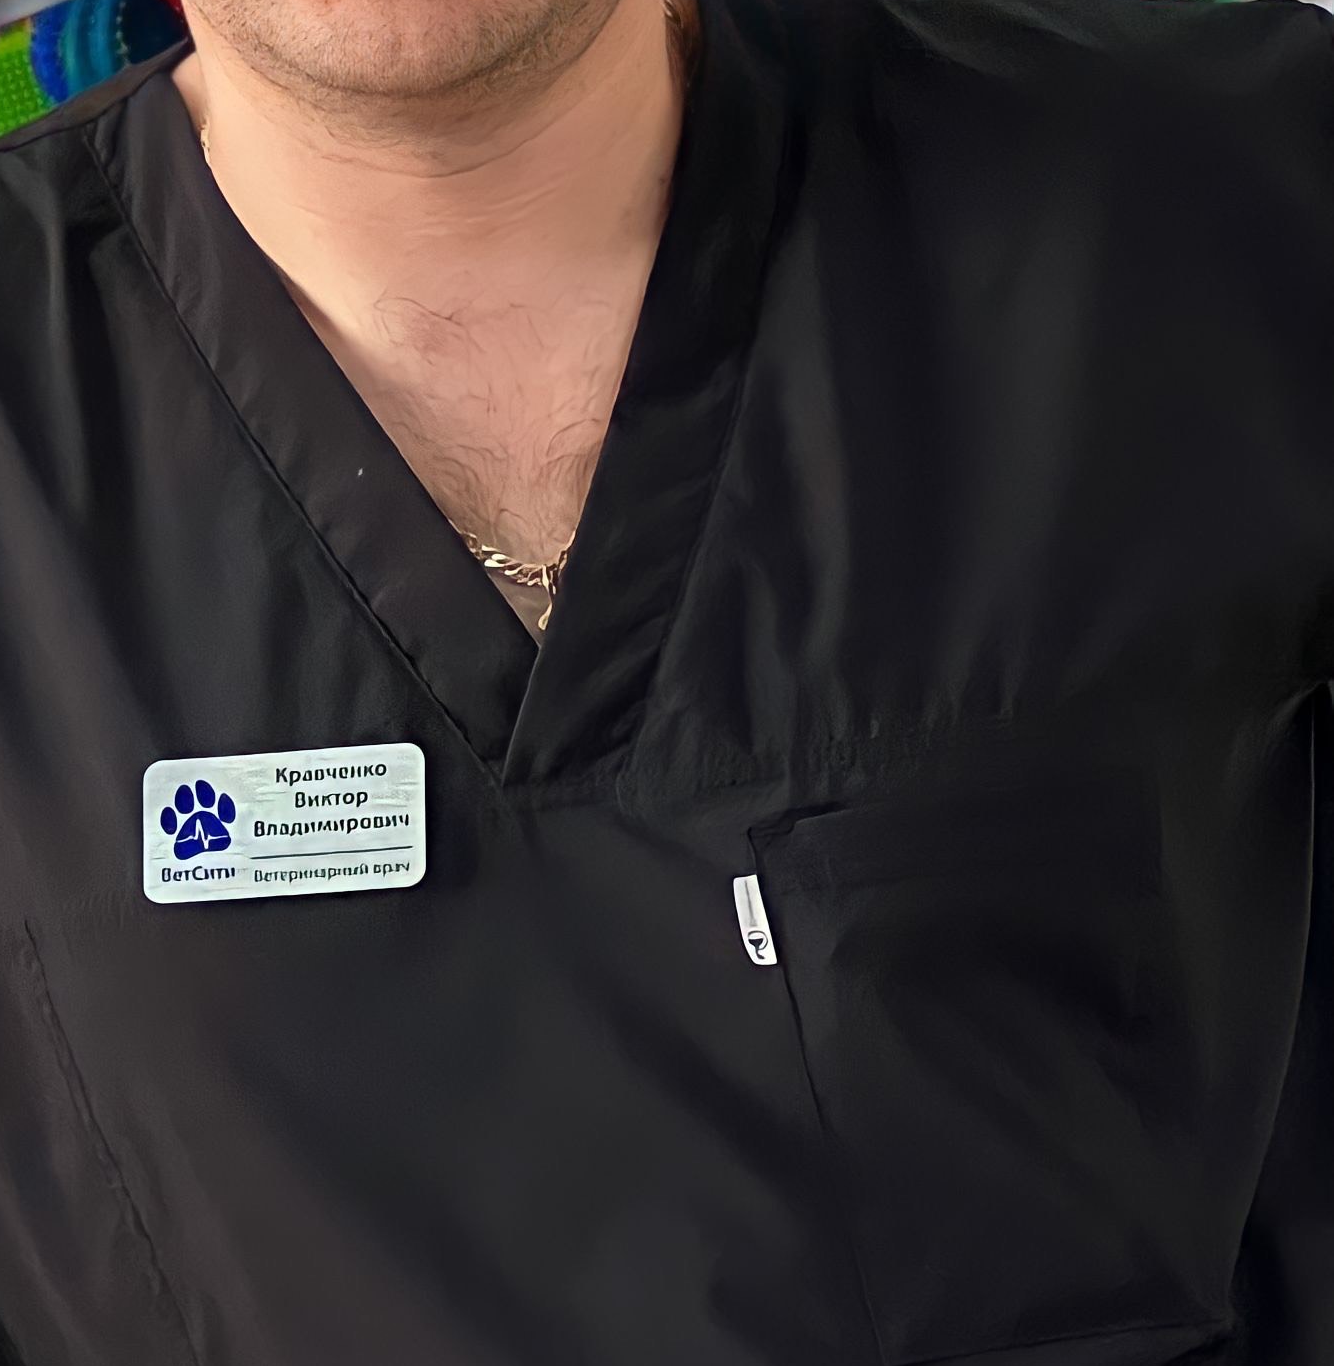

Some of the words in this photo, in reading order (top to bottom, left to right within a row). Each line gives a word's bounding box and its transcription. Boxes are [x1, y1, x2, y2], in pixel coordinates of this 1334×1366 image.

[275, 763, 388, 786] Кравченко
[294, 791, 369, 809] Виктор
[253, 813, 411, 838] Владимирович
